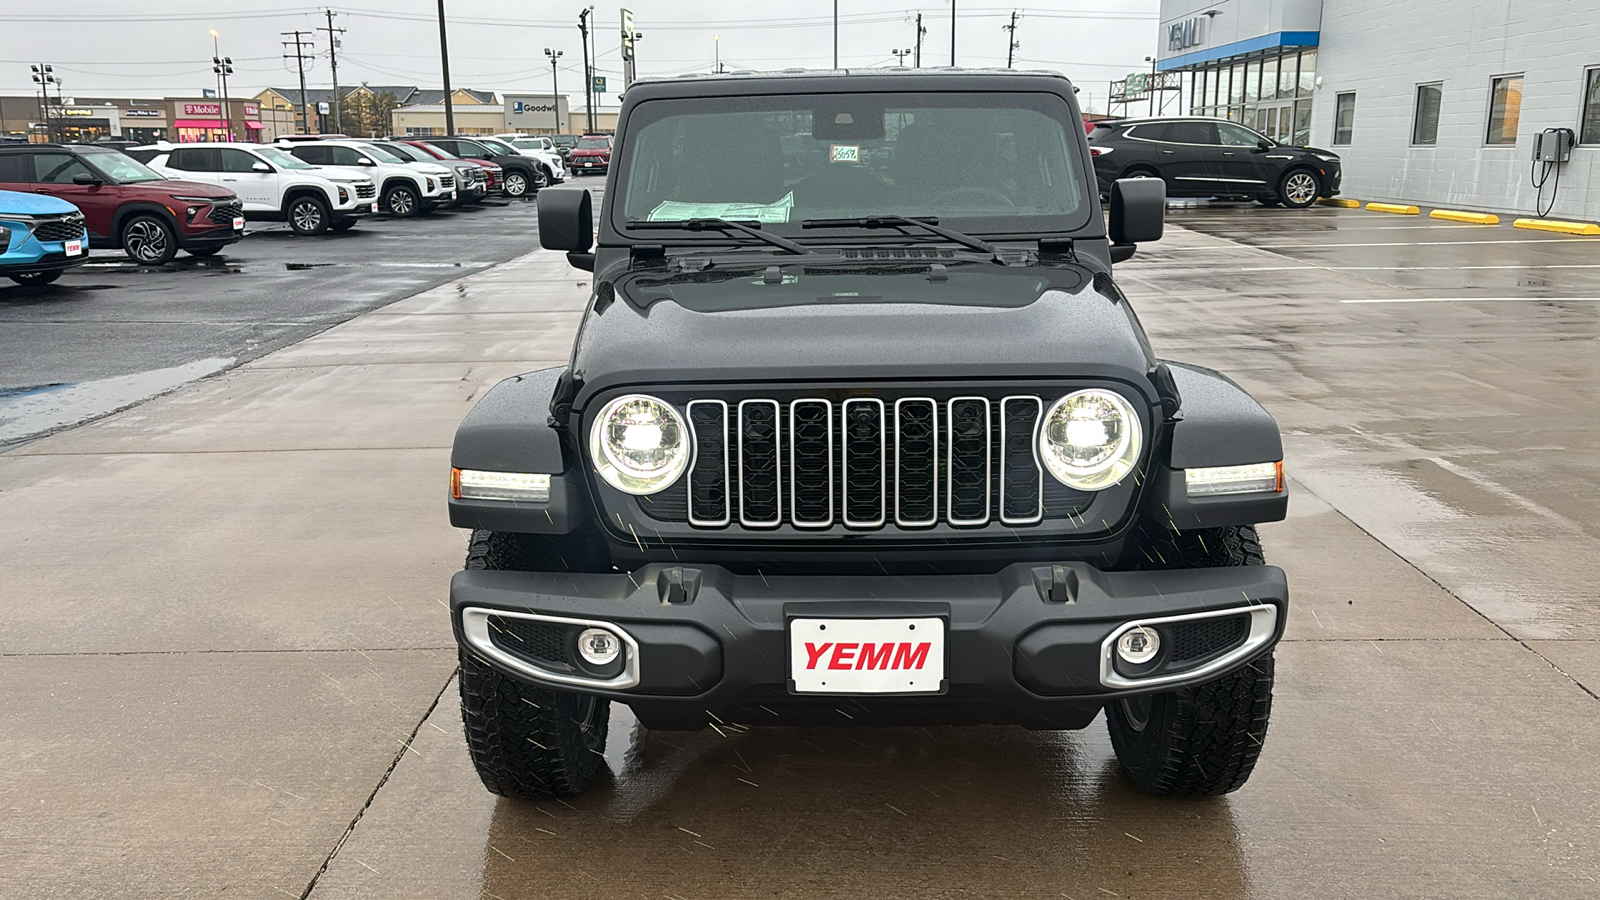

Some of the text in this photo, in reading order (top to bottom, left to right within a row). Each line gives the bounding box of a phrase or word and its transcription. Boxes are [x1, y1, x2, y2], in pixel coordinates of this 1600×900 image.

[193, 105, 218, 114] Mobile
[524, 104, 558, 112] Goodwi
[804, 642, 932, 671] YEMM
